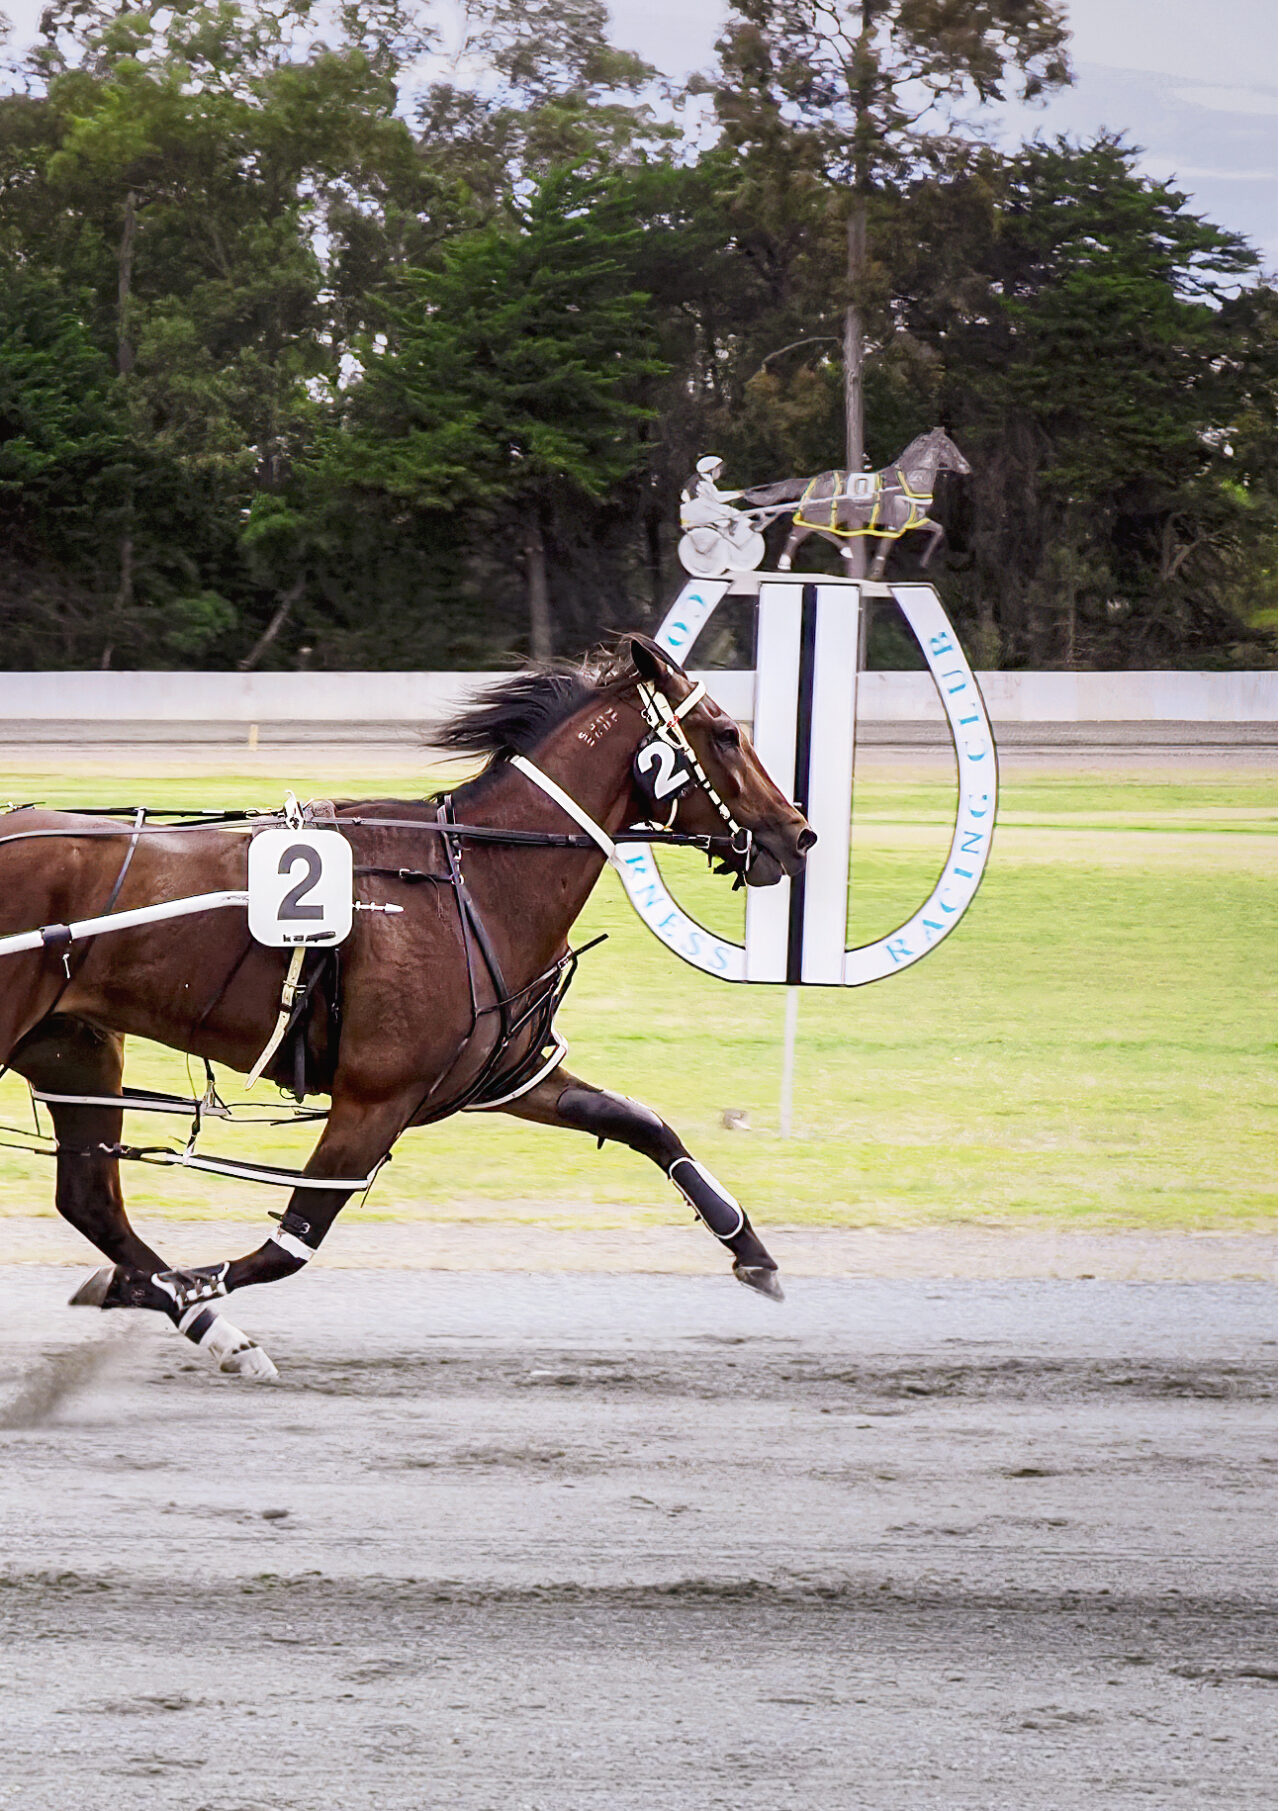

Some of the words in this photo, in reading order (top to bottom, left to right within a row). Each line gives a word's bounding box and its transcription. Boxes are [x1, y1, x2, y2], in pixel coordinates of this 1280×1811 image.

[928, 630, 990, 762] CLUB
[637, 742, 690, 799] 2
[278, 844, 324, 920] 2
[625, 855, 731, 971] RNESS
[885, 795, 989, 964] RACING
